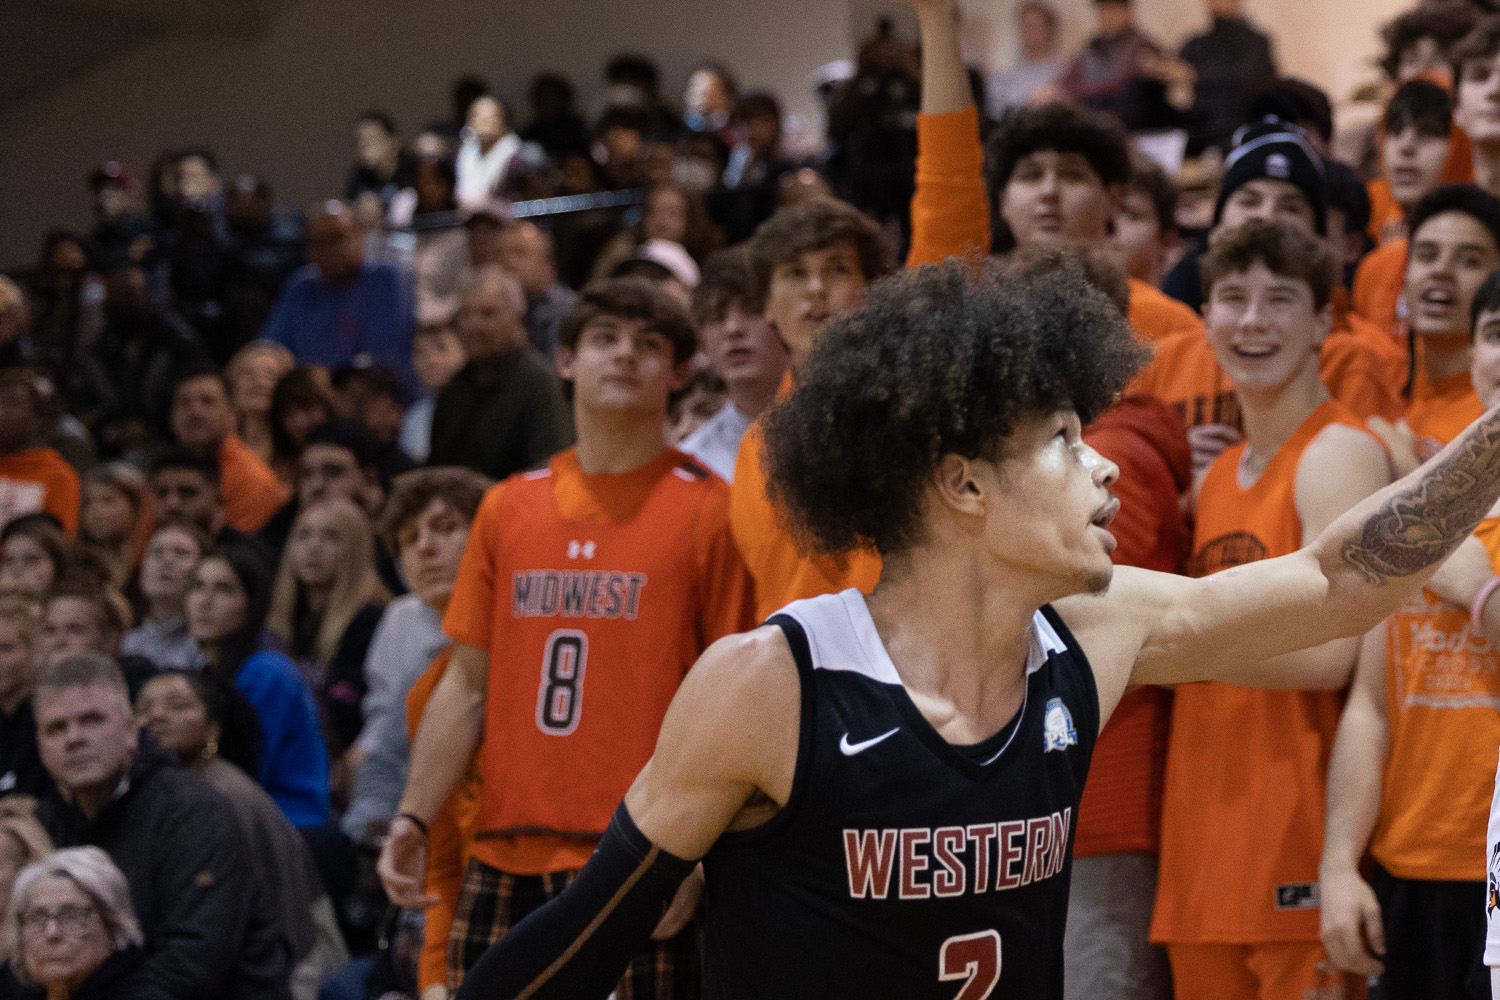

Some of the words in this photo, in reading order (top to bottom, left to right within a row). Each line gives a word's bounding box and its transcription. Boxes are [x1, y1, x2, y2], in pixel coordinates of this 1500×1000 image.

[513, 569, 647, 620] MIDWEST
[535, 628, 589, 736] 8
[843, 807, 1071, 899] WESTERN
[938, 929, 1001, 1000] 2
